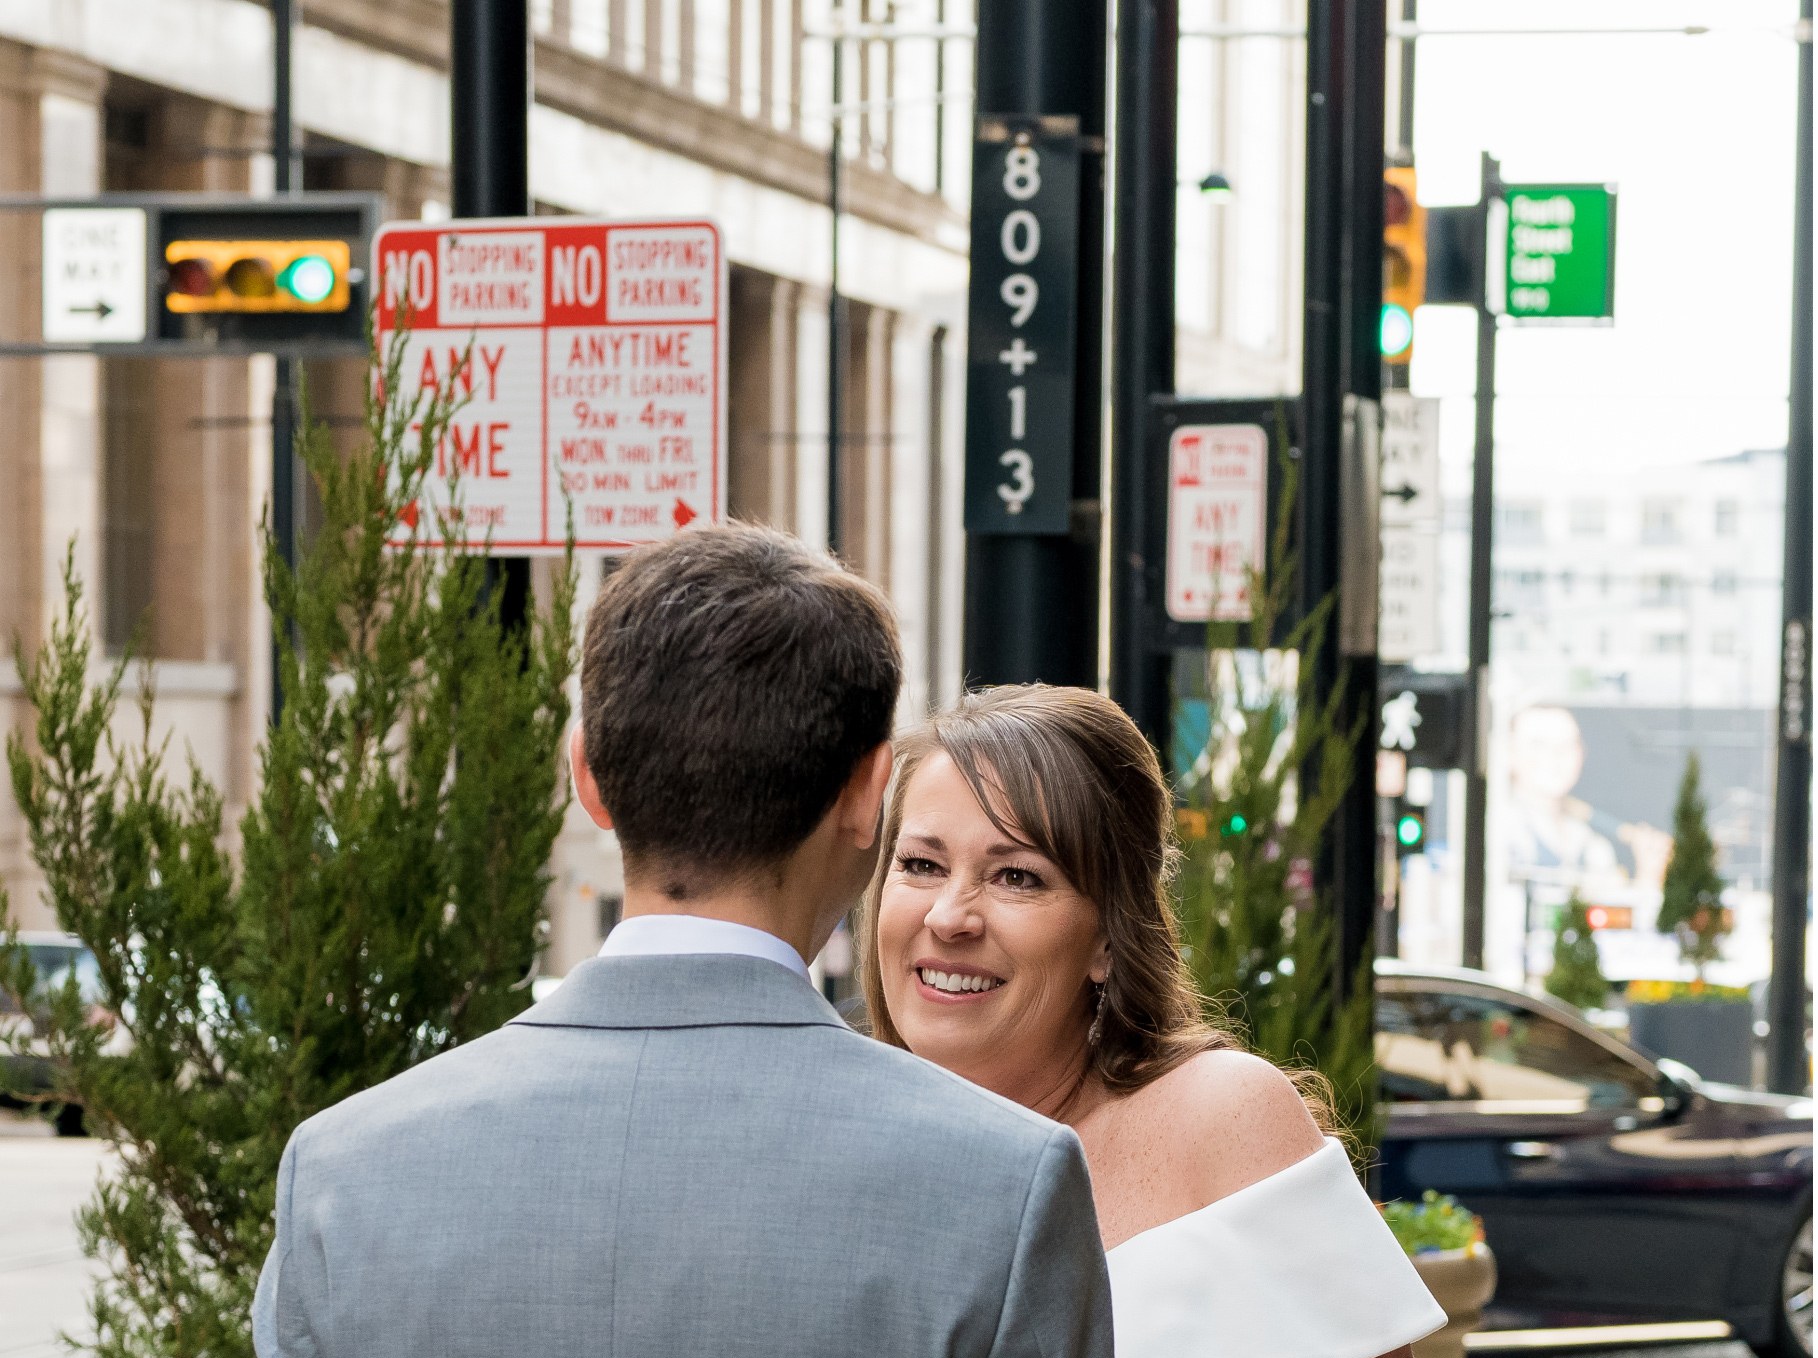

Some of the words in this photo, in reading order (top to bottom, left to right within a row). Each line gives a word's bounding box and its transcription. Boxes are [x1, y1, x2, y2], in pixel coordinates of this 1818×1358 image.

[447, 243, 535, 273] STOPPING
[616, 239, 705, 269] STOPPING
[384, 249, 433, 310] NO
[551, 245, 600, 306] NO
[450, 281, 530, 310] PARKING
[619, 276, 700, 307] PARKING
[567, 331, 692, 368] ANYTIME
[419, 346, 505, 402] ANY
[552, 374, 622, 397] EXCEPT
[629, 373, 707, 396] LOADING
[639, 400, 686, 428] 4PM
[643, 470, 698, 492] LIMIT
[584, 505, 615, 526] TOW
[620, 505, 661, 525] ZONE
